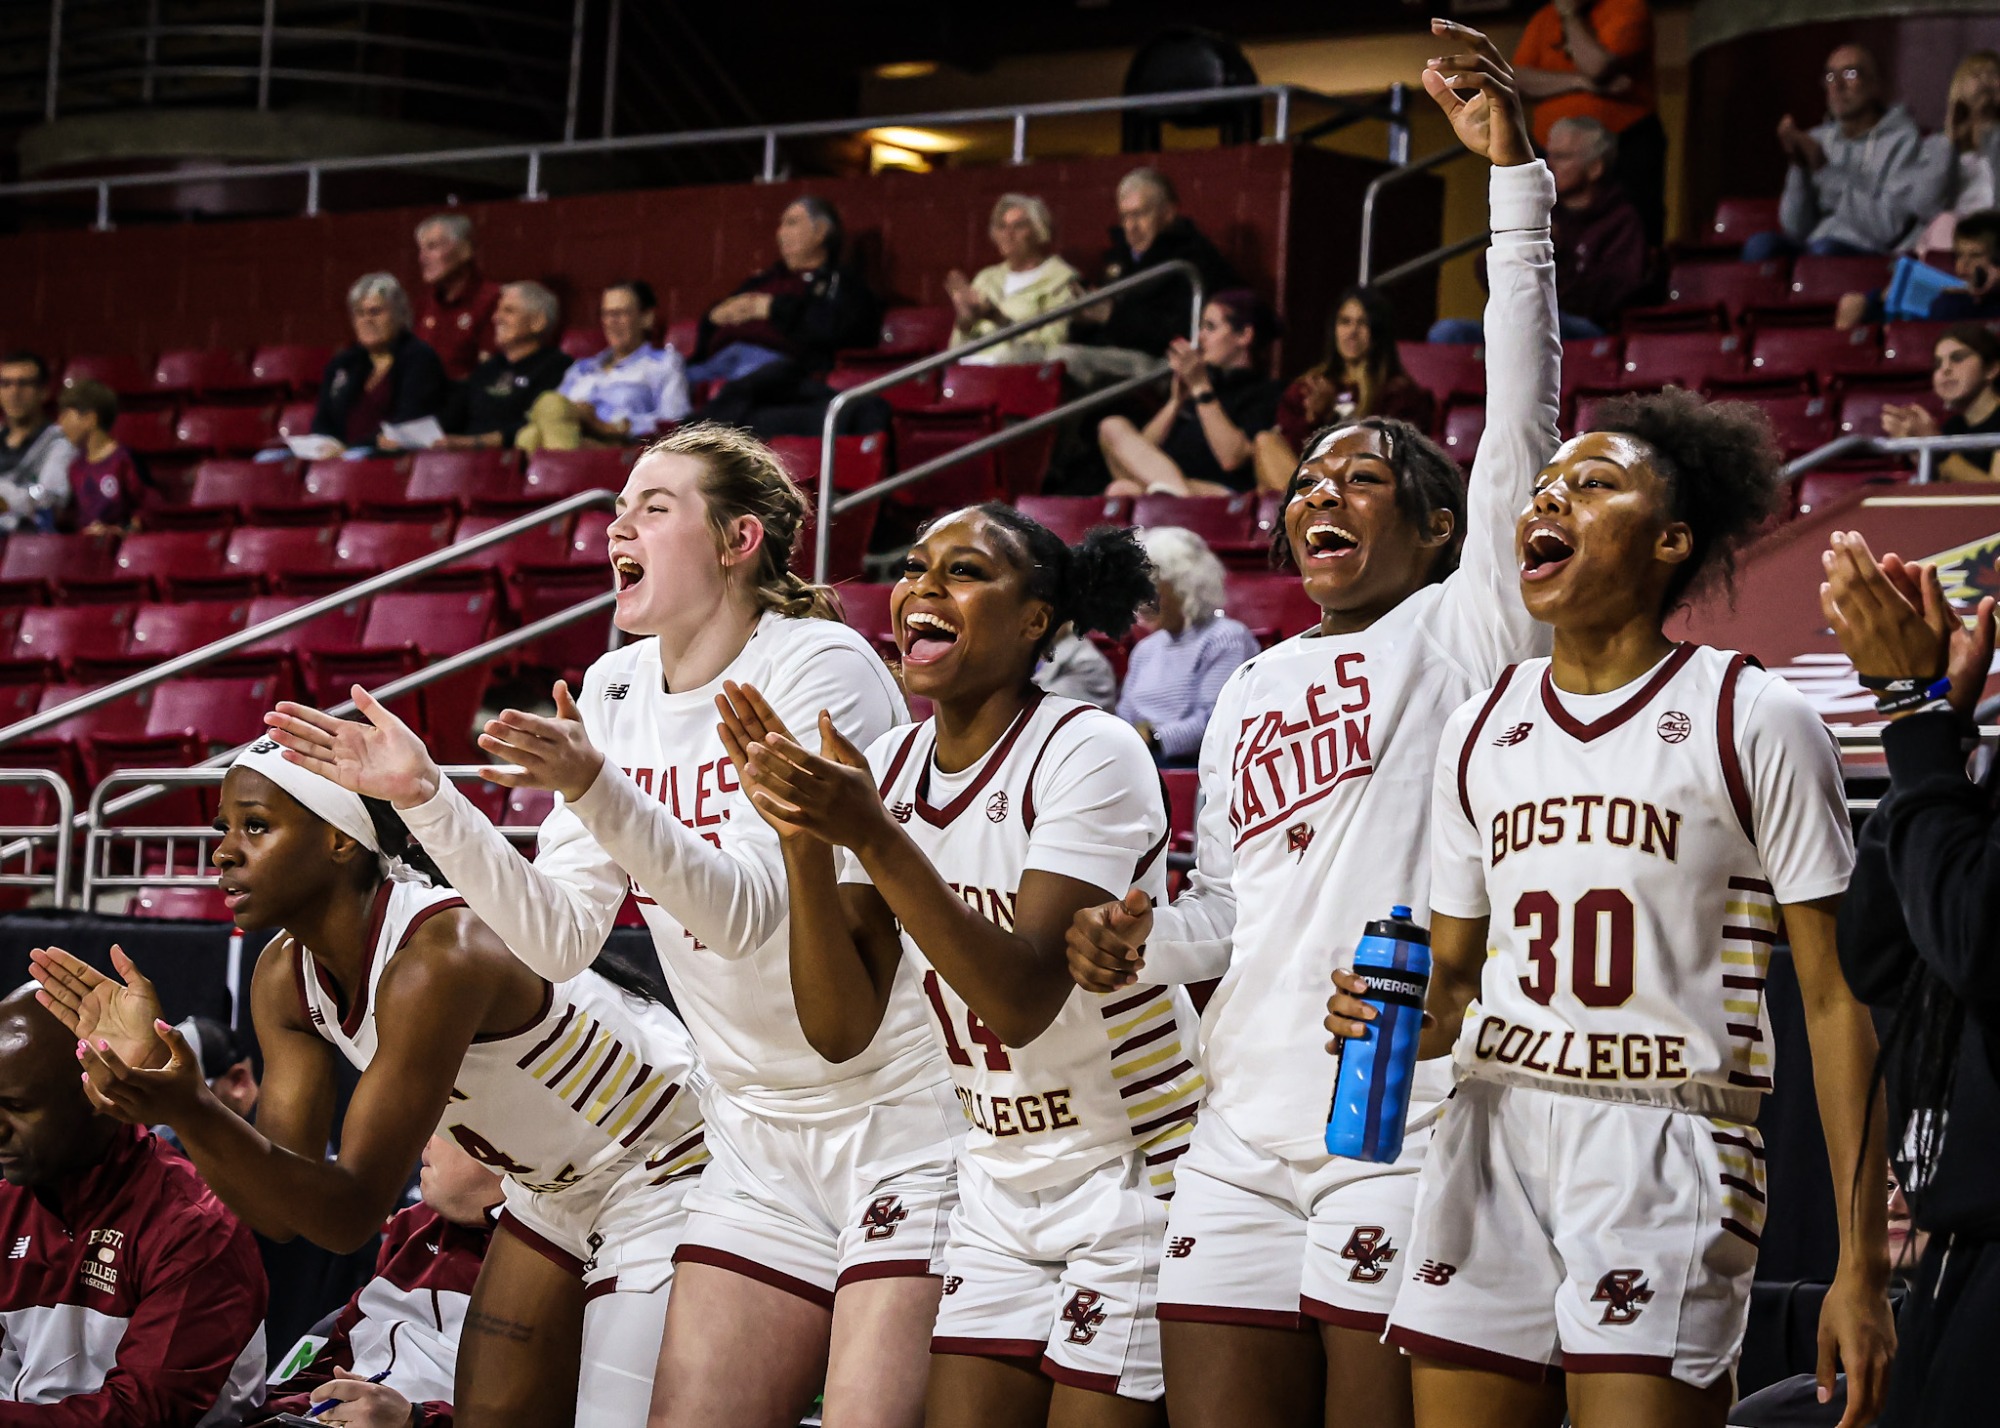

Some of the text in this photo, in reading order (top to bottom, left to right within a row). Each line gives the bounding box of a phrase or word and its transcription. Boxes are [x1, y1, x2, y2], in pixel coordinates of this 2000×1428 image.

[1490, 794, 1684, 869] BOSTON
[1512, 887, 1637, 1010] 30
[1363, 975, 1424, 997] OWERADE
[922, 969, 1014, 1073] 14
[1475, 1014, 1690, 1080] COLLEGE
[953, 1082, 1081, 1138] OLLEGE
[80, 1260, 118, 1284] COLLEG
